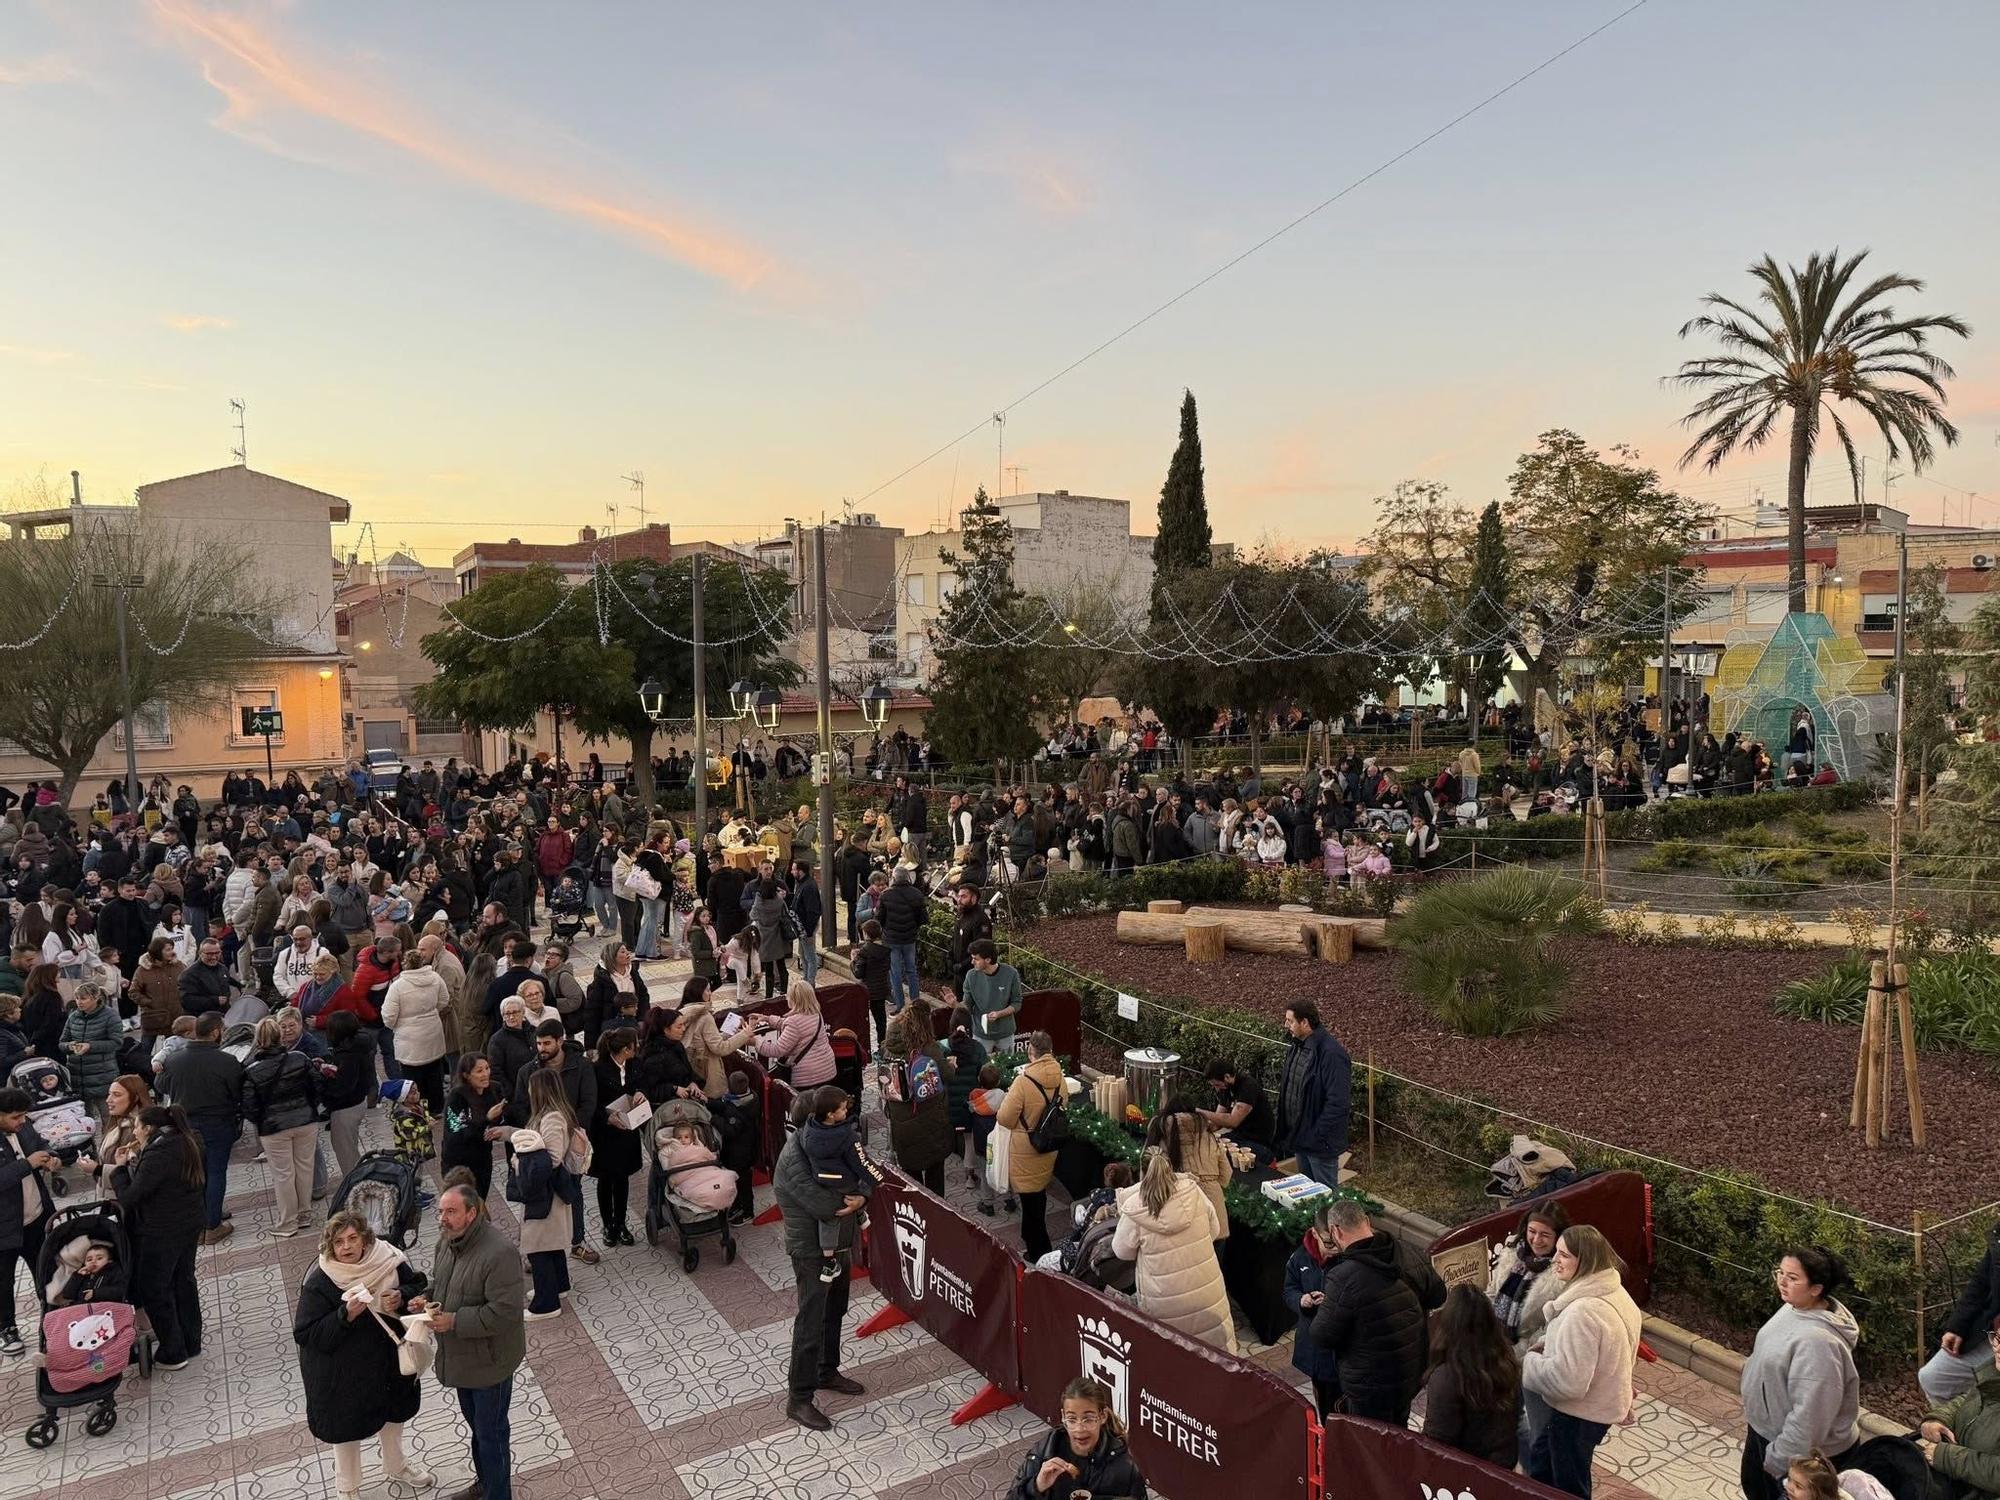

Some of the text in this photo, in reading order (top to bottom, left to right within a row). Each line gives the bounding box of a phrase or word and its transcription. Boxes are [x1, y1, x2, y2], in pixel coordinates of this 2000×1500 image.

[929, 1271, 977, 1318] PETRER
[930, 1257, 973, 1295] Ayuntamiento de
[1443, 1260, 1480, 1282] Chocolate
[1140, 1387, 1218, 1440] Ayuntamiento de
[1140, 1404, 1221, 1466] PETRER
